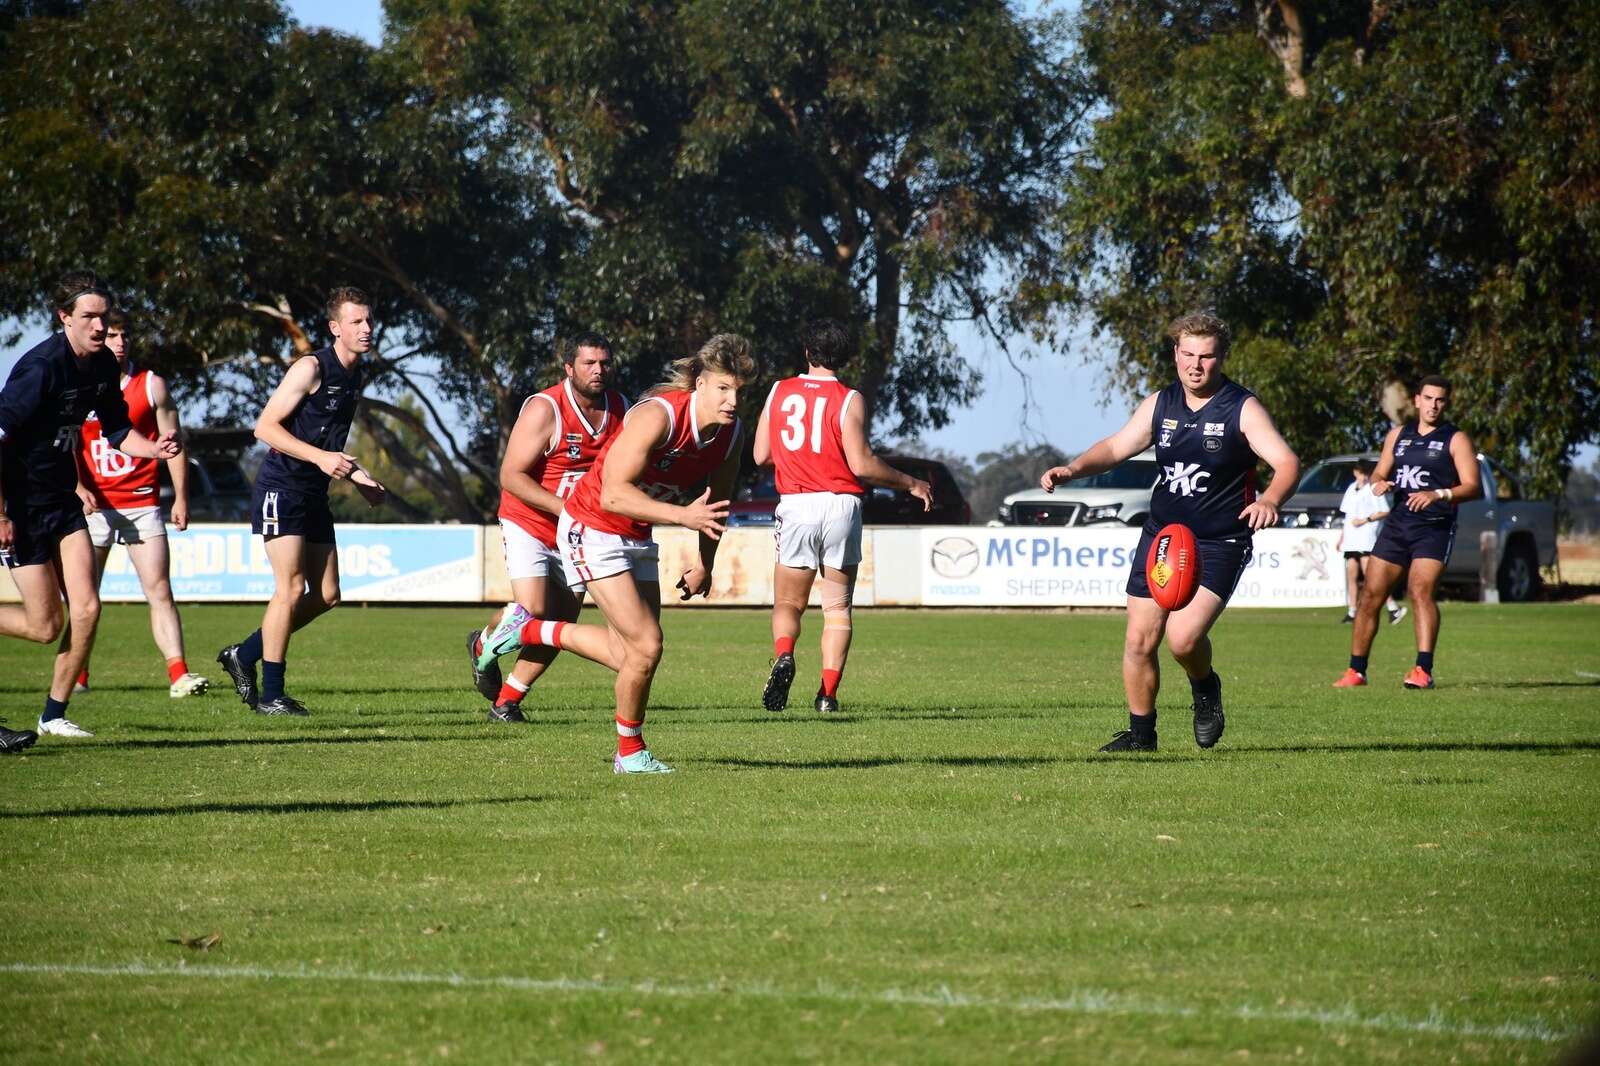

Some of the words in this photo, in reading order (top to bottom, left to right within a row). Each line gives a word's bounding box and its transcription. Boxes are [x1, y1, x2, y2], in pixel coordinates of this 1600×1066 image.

[781, 394, 828, 454] 31
[986, 536, 1135, 568] McPhers
[1006, 578, 1129, 597] SHEPPARTO
